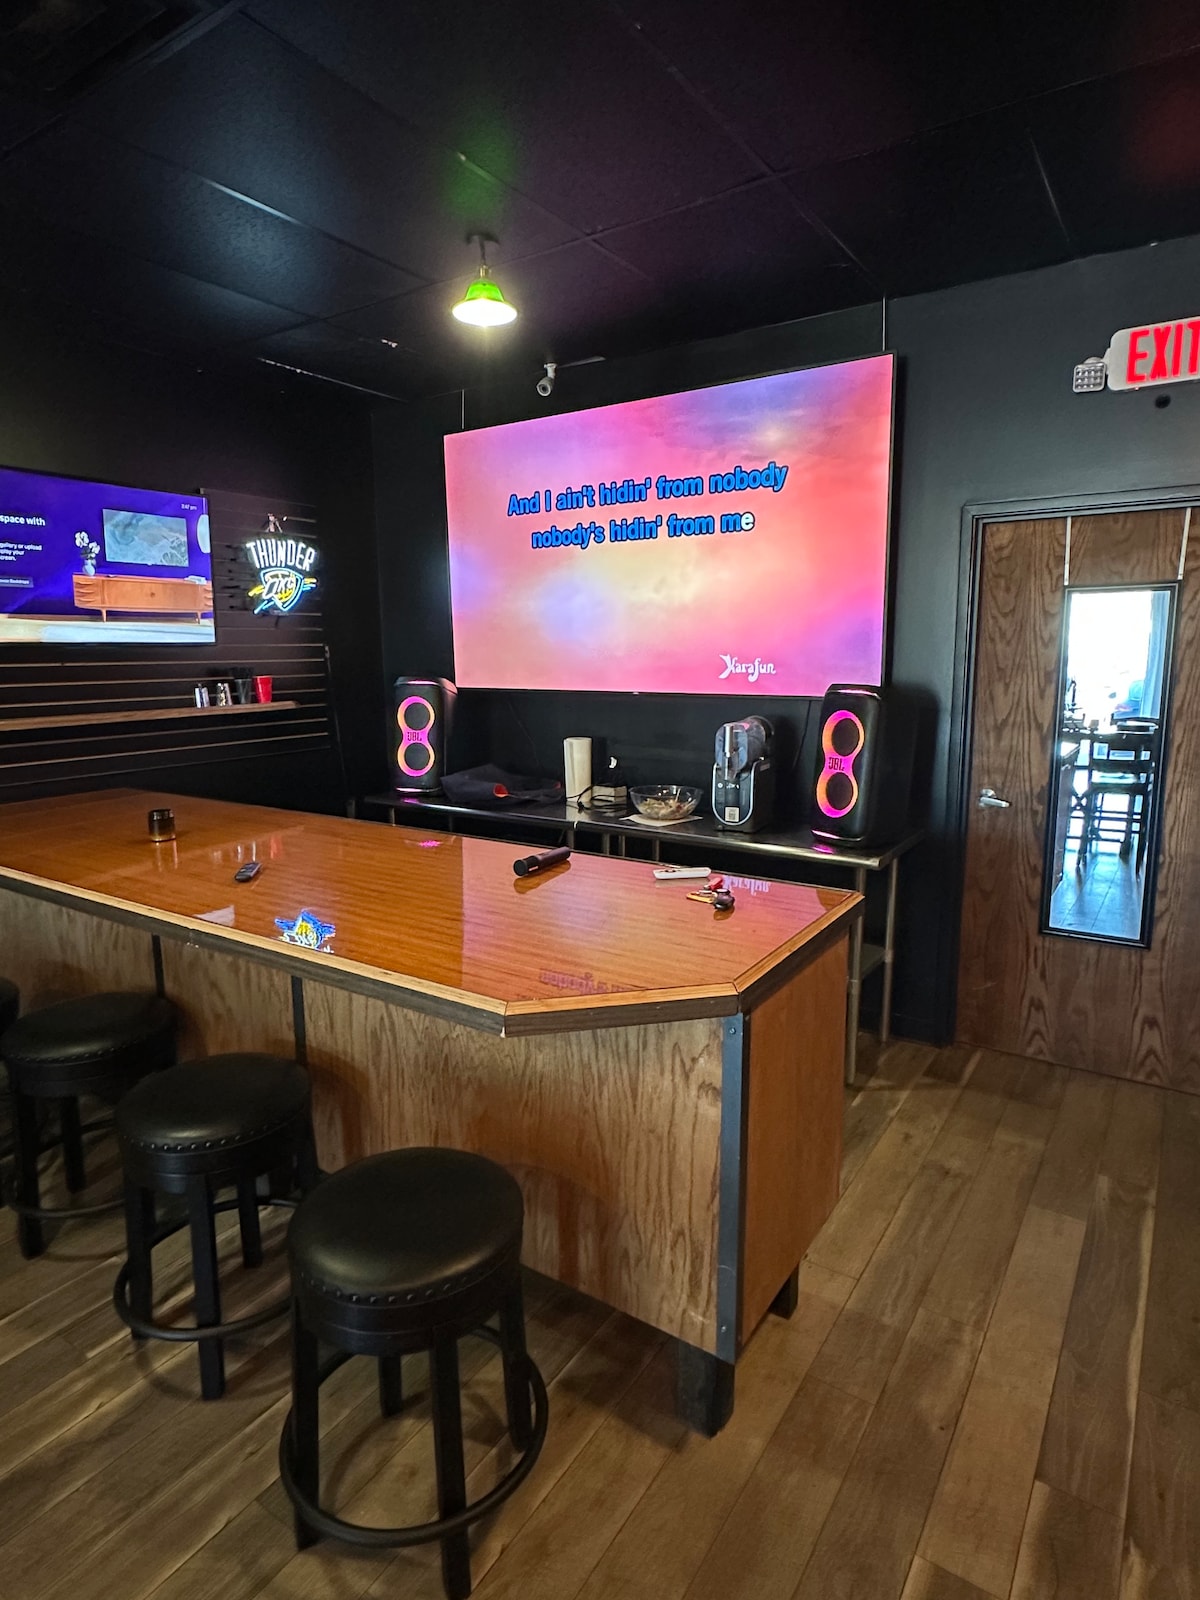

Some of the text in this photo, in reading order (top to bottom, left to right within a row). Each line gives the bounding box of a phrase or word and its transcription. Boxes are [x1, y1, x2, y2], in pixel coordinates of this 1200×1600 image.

[1126, 320, 1200, 384] EXIT
[507, 461, 789, 516] And I ain't hidin' from nobody
[0, 514, 46, 527] space with
[531, 511, 755, 549] nobody's hidin' from me
[245, 538, 316, 572] THUNDER
[407, 731, 423, 742] JBL
[828, 756, 846, 772] JBL
